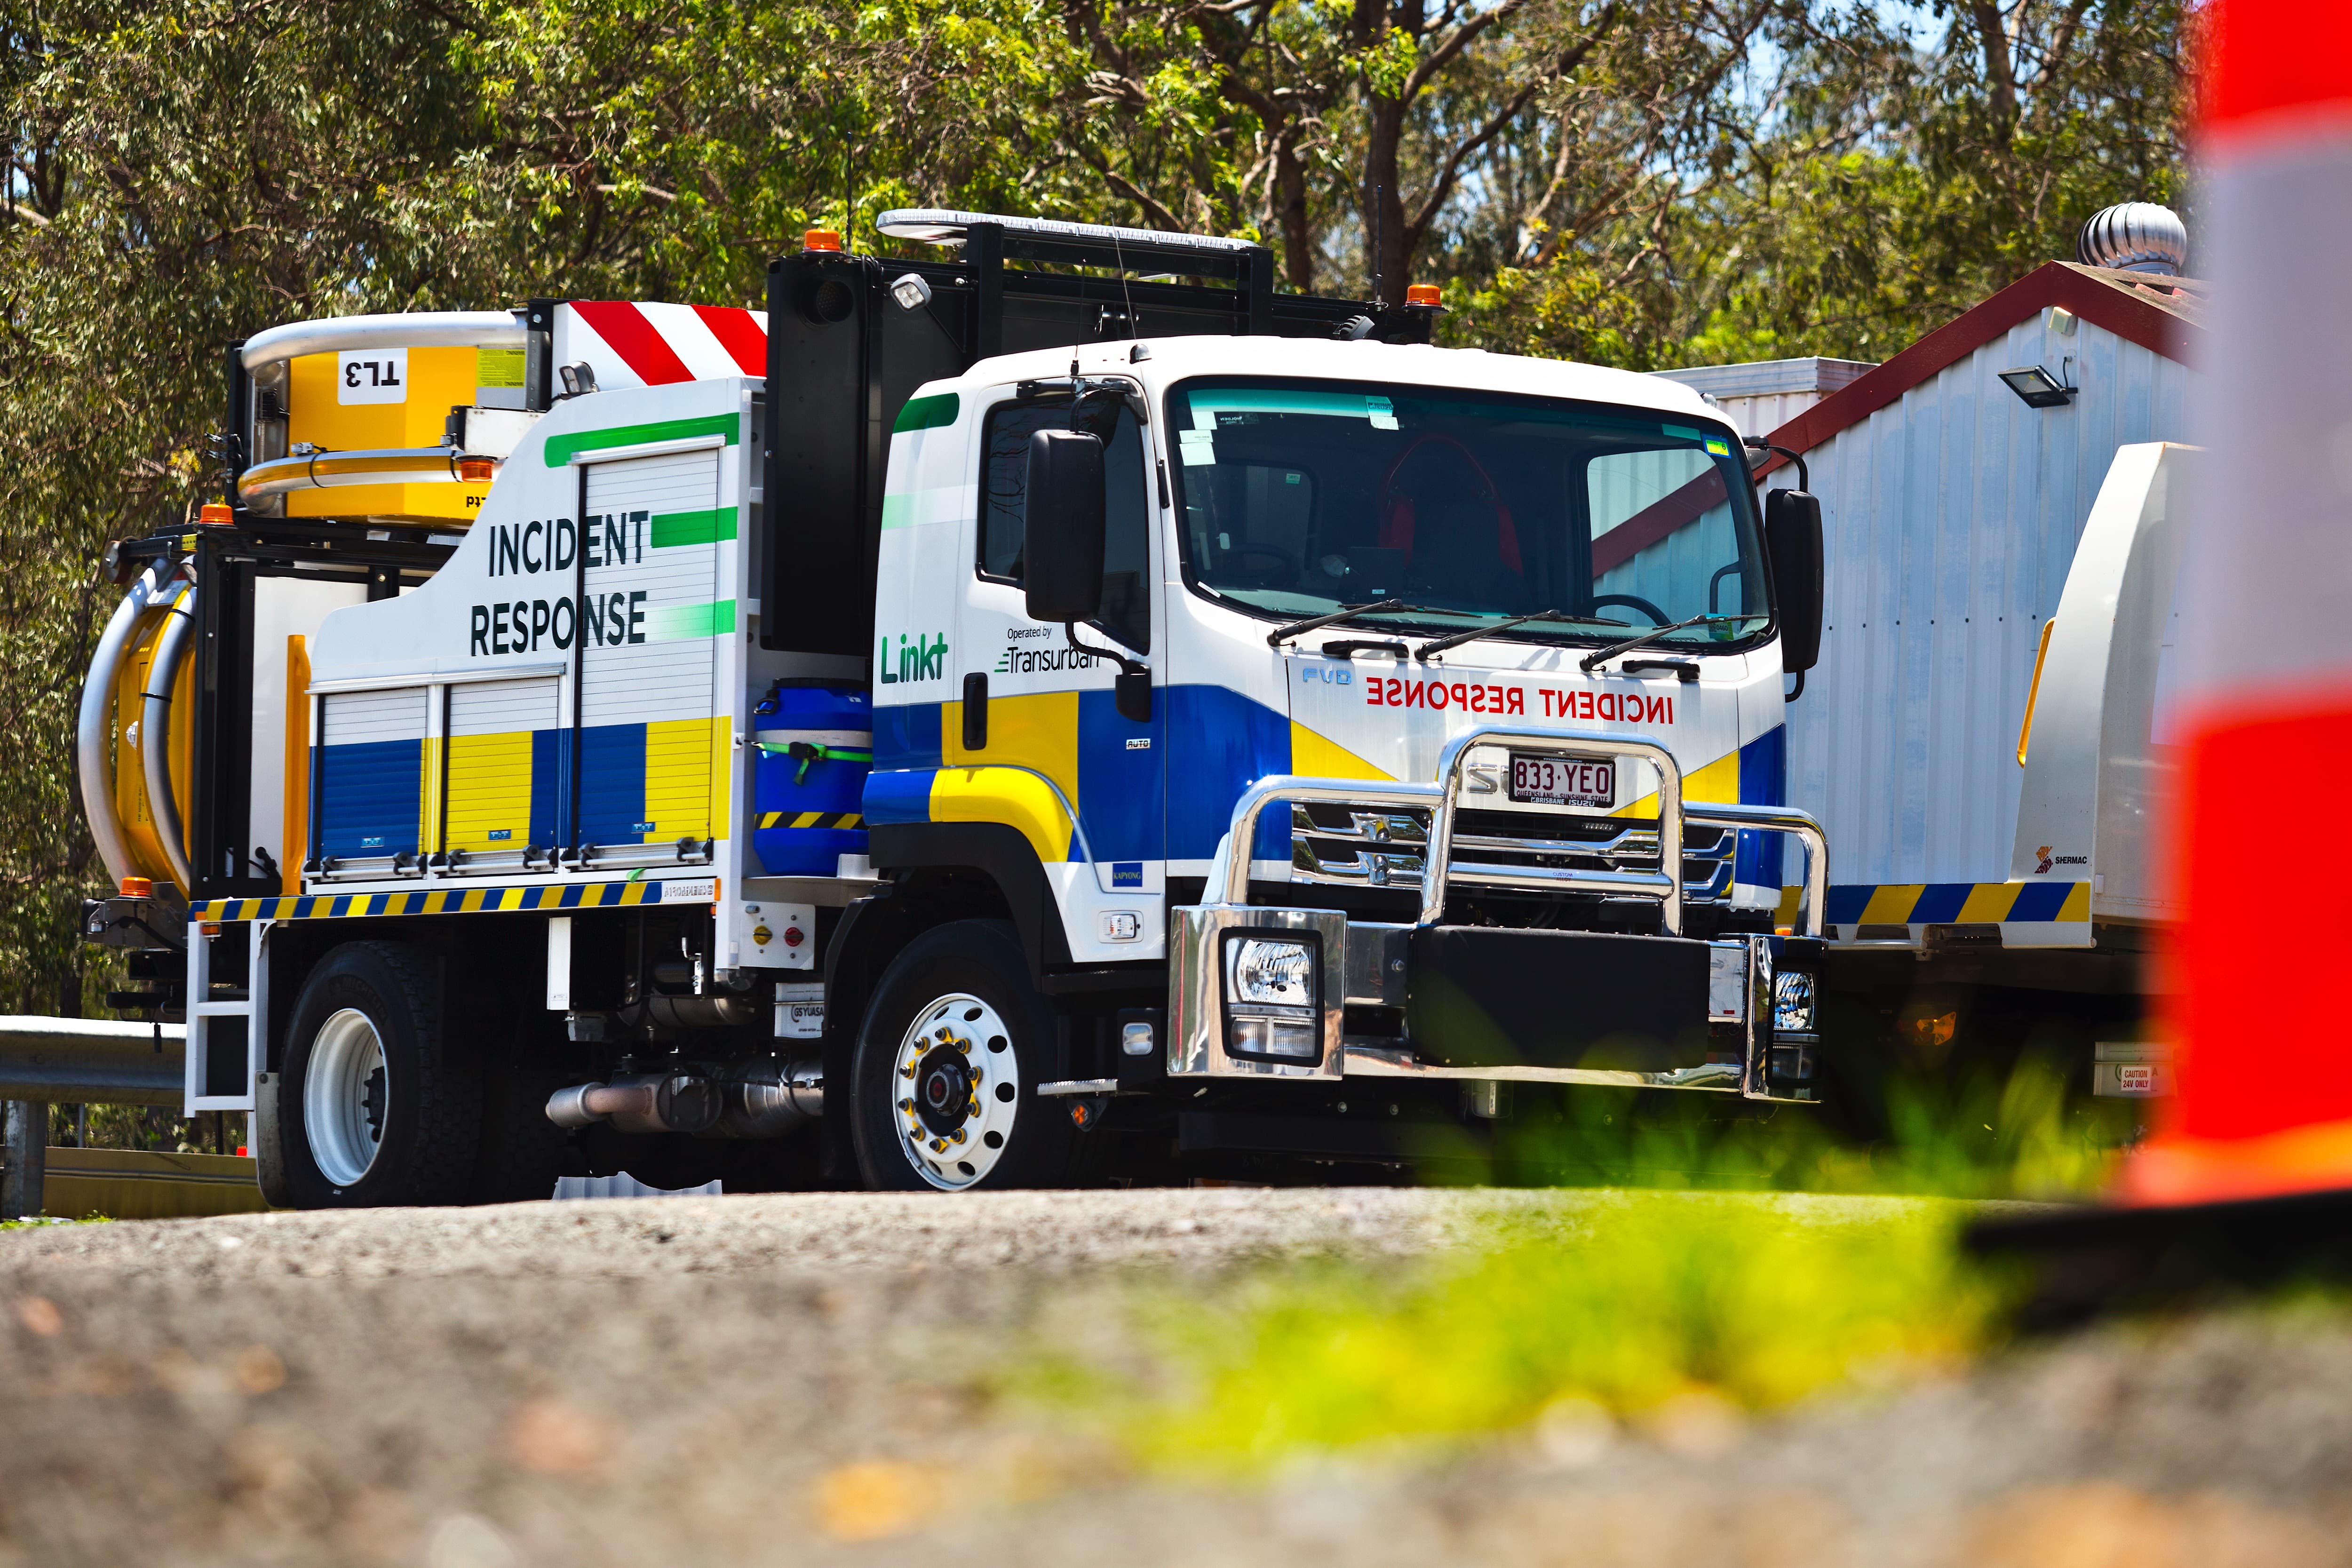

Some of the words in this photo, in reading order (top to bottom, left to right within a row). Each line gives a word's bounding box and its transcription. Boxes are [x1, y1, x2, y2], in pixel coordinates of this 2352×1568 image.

[346, 361, 399, 388] TL3
[466, 496, 486, 508] td
[489, 510, 648, 577] INCIDENT
[471, 591, 646, 656] RESPONSE
[1008, 626, 1041, 642] Operated
[1042, 625, 1052, 639] by
[881, 632, 948, 684] Linkt
[1303, 668, 1351, 685] FVD
[794, 1008, 803, 1017] GS
[803, 1007, 824, 1017] YUASA
